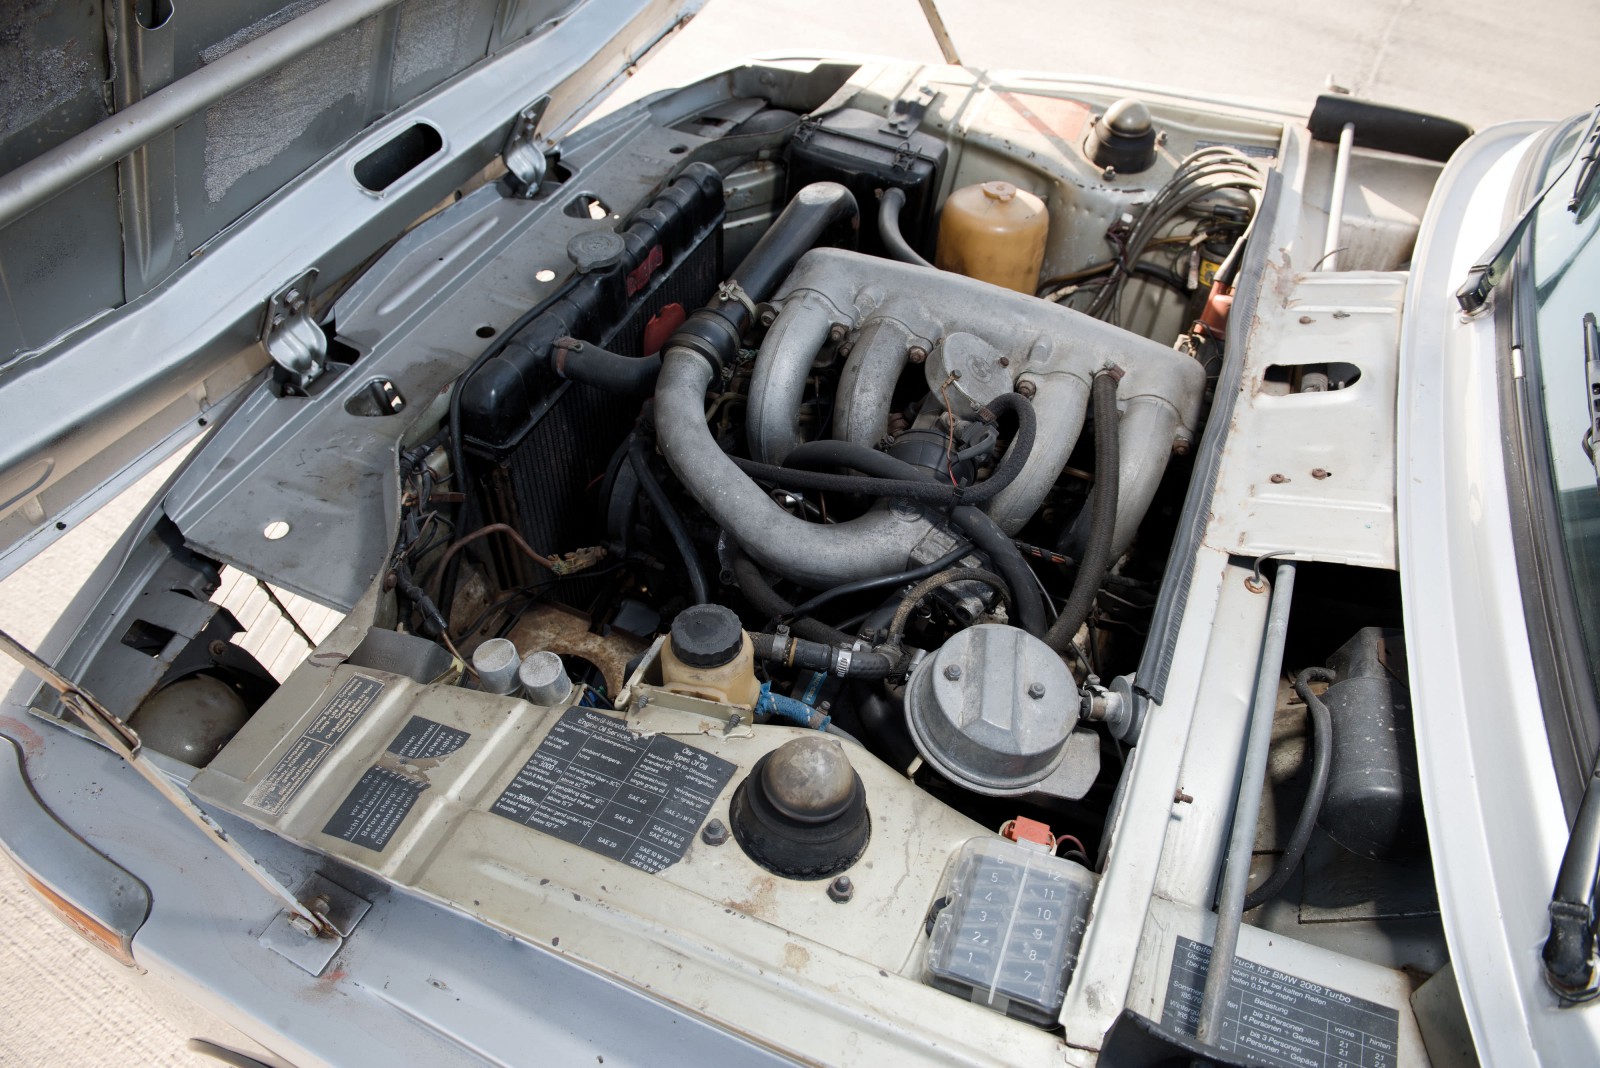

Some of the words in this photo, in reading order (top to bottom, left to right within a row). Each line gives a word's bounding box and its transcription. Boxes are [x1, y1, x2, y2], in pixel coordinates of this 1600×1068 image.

[577, 717, 597, 728] Engine
[606, 727, 630, 741] Services
[543, 740, 562, 749] intervals
[553, 737, 569, 745] change
[581, 747, 600, 756] ambient
[538, 760, 554, 770] 3000
[643, 757, 664, 768] branded
[673, 752, 690, 763] Types
[698, 762, 708, 770] Oil
[639, 763, 658, 773] engines
[360, 813, 380, 836] Before
[428, 731, 446, 752] always
[516, 776, 540, 788] throughout
[643, 783, 658, 791] grade
[516, 793, 532, 803] 3000
[546, 795, 561, 803] above
[551, 789, 577, 802] throughout
[627, 793, 640, 801] SAE
[350, 804, 359, 815] vor
[499, 804, 516, 813] months
[517, 803, 531, 811] every
[664, 807, 675, 815] SAE
[370, 803, 397, 838] disconnect
[395, 792, 405, 802] the
[530, 815, 544, 824] below
[614, 813, 626, 821] SAE
[343, 819, 359, 836] Nicht
[357, 808, 368, 818] bei
[375, 807, 404, 844] Disconnect
[652, 824, 665, 833] SAE
[648, 831, 661, 839] SAE
[597, 836, 610, 845] SAE
[638, 845, 651, 854] SAE
[634, 852, 647, 861] SAE
[629, 858, 643, 867] SAE
[992, 872, 998, 882] 5
[1048, 870, 1060, 880] 12
[985, 892, 992, 902] 4
[1044, 888, 1054, 900] 11
[980, 910, 987, 922] 3
[1038, 908, 1051, 920] 10
[972, 931, 981, 941] 2
[1034, 928, 1042, 939] 9
[968, 952, 973, 963] 1
[1029, 950, 1037, 960] 8
[1024, 970, 1032, 982] 7
[1257, 965, 1269, 974] für
[1272, 970, 1297, 984] BMW
[1299, 980, 1321, 993] 2002
[1324, 987, 1351, 1003] Turbo
[1250, 982, 1261, 990] 0,3
[1262, 986, 1274, 994] bar
[1275, 992, 1296, 1003] mehr)
[1257, 977, 1269, 985] bar
[1282, 986, 1303, 997] kalten
[1304, 993, 1326, 1005] Reifen
[1253, 997, 1288, 1015] Belastung
[1252, 1009, 1263, 1018] bis
[1270, 1016, 1303, 1032] Personen
[1248, 1016, 1281, 1032] Personen
[1292, 1032, 1319, 1046] Gepäck
[1334, 1027, 1354, 1037] vorne
[1250, 1030, 1261, 1039] bis
[1268, 1036, 1302, 1053] Personen
[1338, 1040, 1348, 1048] 2,1
[1369, 1037, 1390, 1049] hinten
[1246, 1037, 1280, 1054] Personen
[1290, 1053, 1318, 1068] Gepäck
[1338, 1048, 1348, 1056] 2,1
[1374, 1052, 1384, 1060] 2,1
